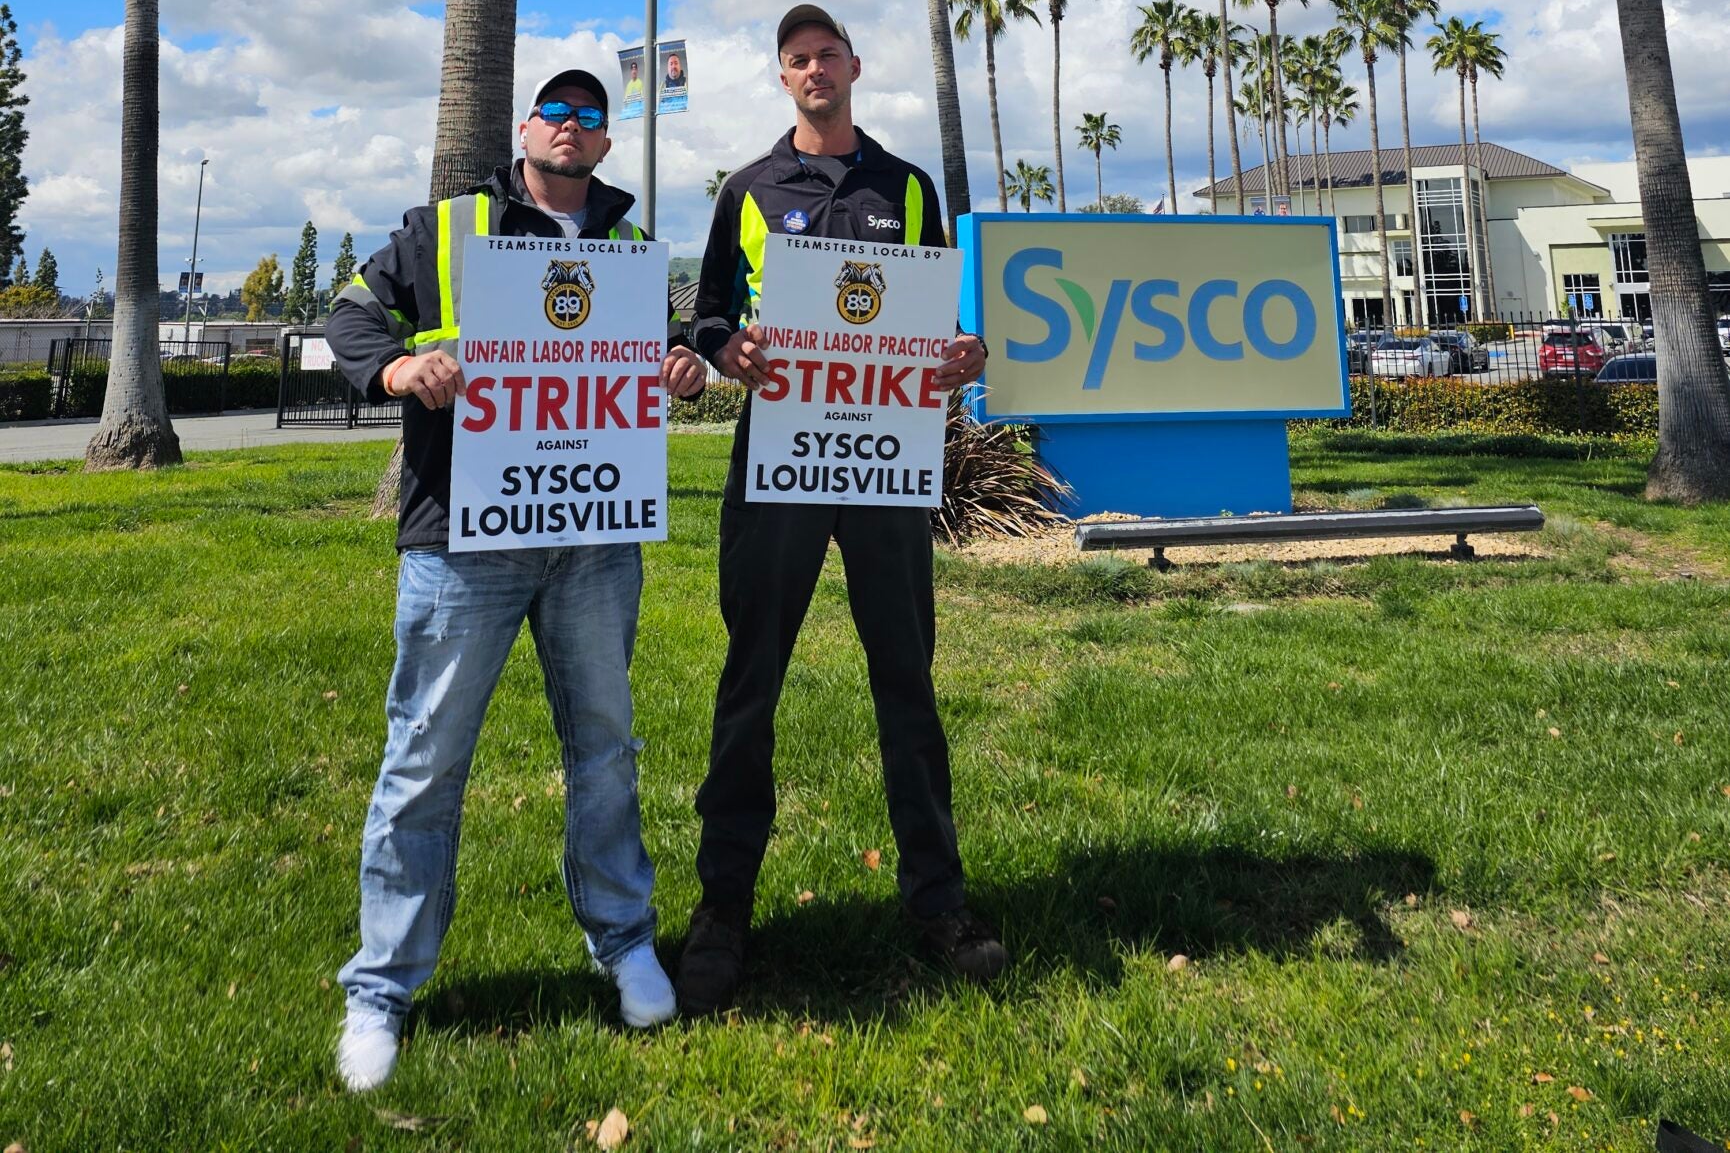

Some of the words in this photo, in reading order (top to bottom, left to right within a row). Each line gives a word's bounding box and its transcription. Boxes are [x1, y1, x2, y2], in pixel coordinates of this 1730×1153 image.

[867, 214, 901, 230] Sysco
[488, 240, 572, 252] TEAMSTERS
[579, 242, 623, 254] LOCAL
[631, 244, 648, 255] 89
[786, 238, 866, 255] TEAMSTERS
[873, 246, 916, 259] LOCAL
[924, 250, 942, 260] 89
[555, 295, 581, 314] 89
[846, 294, 871, 311] 89
[464, 340, 526, 363] UNFAIR
[532, 340, 584, 363] LABOR
[590, 340, 661, 363] PRACTICE
[763, 326, 818, 350] UNFAIR
[823, 331, 873, 354] LABOR
[878, 335, 949, 359] PRACTICE
[758, 358, 942, 409] STRIKE
[461, 375, 661, 433] STRIKE
[824, 411, 873, 422] AGAINST
[536, 439, 589, 451] AGAINST
[791, 431, 901, 461] SYSCO
[500, 462, 621, 496] SYSCO
[755, 463, 933, 496] LOUISVILLE
[461, 498, 657, 538] LOUISVILLE
